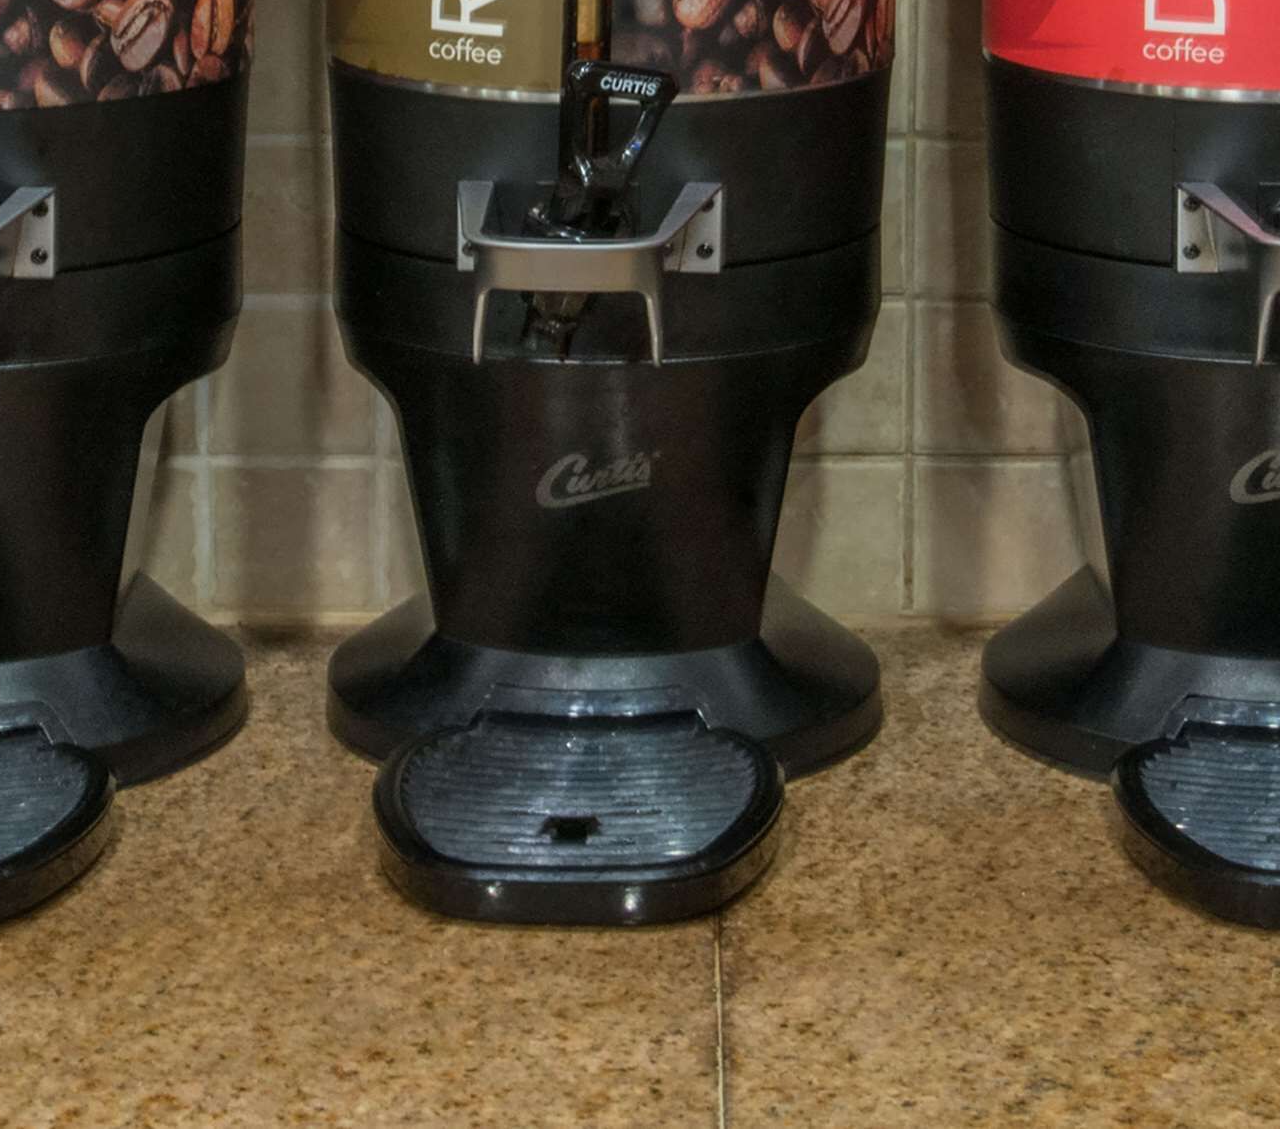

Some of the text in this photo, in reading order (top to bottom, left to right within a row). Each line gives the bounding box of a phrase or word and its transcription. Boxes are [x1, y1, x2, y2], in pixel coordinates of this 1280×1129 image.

[429, 37, 502, 65] coffee
[1143, 37, 1225, 65] coffee
[600, 76, 657, 97] CURTIS
[535, 452, 652, 509] Curtis
